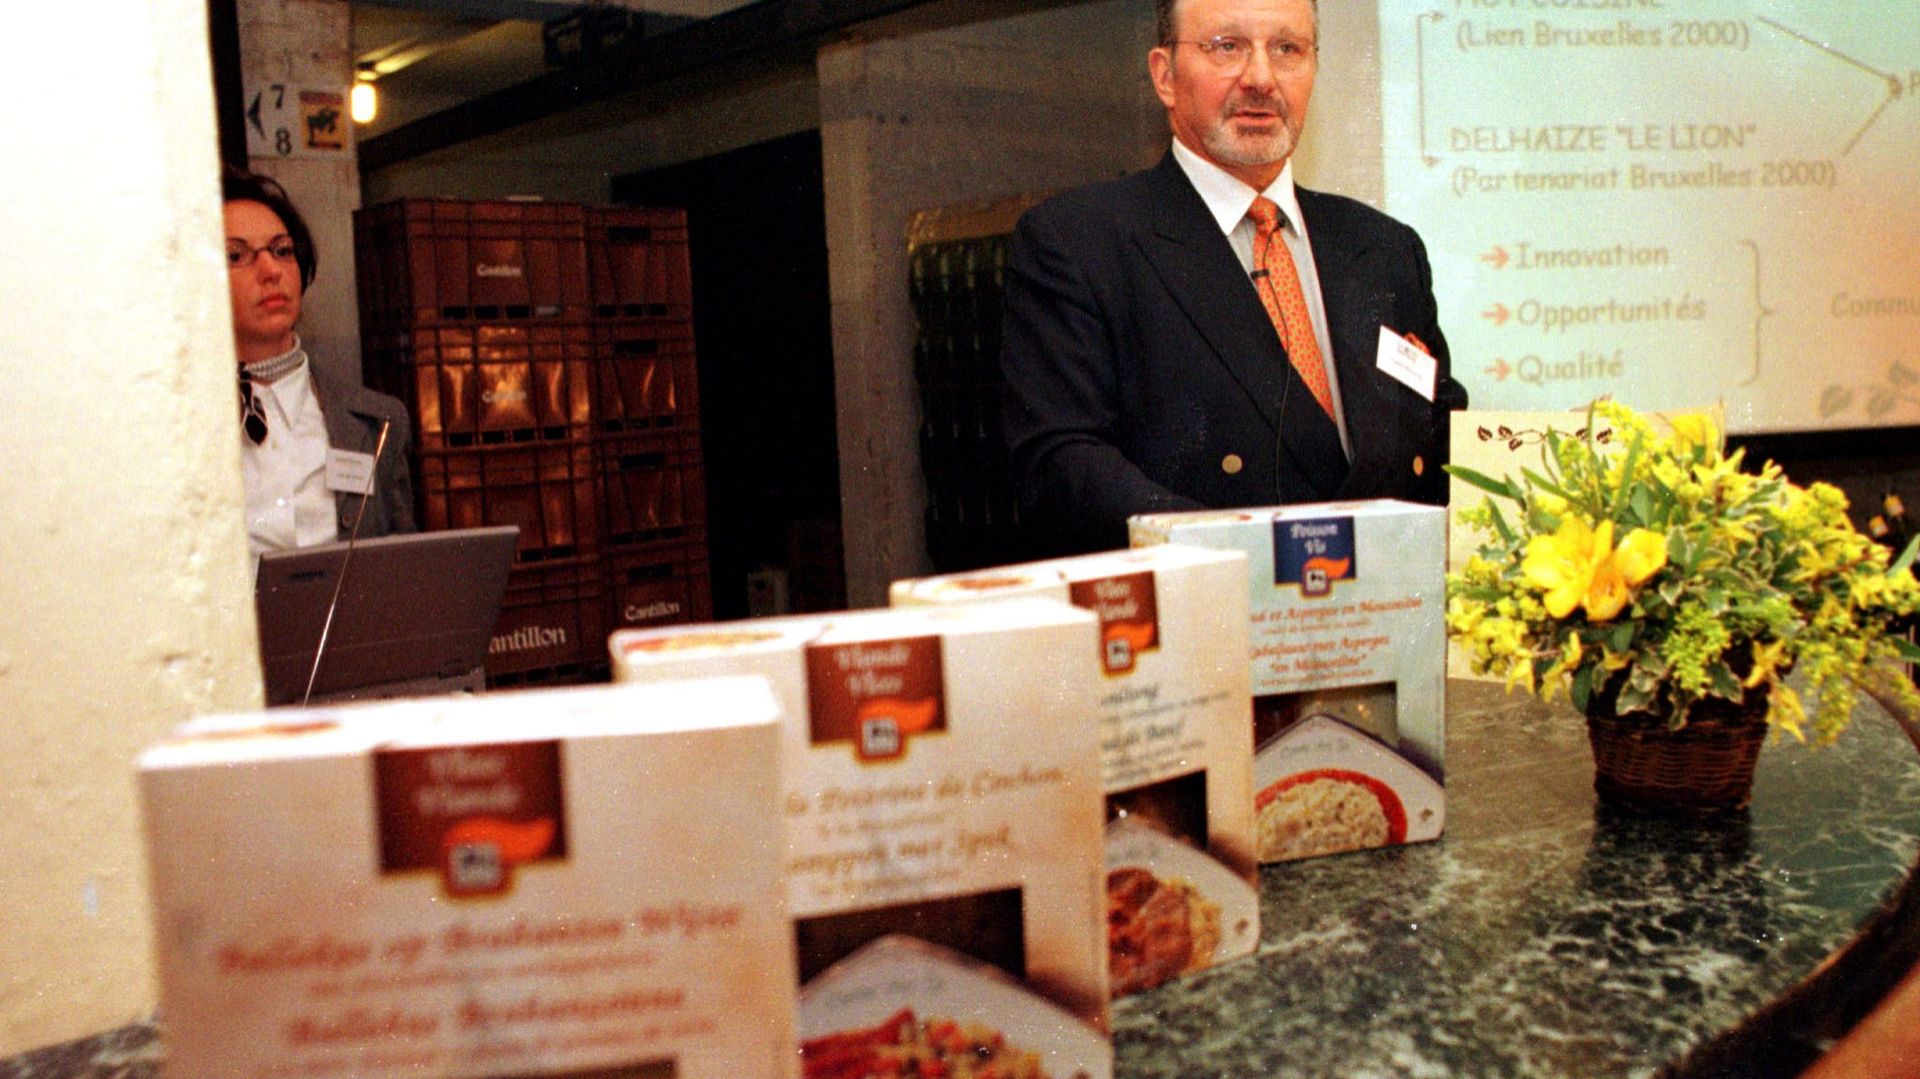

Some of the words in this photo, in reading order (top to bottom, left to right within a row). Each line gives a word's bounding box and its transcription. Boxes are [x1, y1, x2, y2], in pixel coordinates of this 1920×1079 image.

[1457, 20, 1524, 51] (Lien
[1535, 20, 1661, 47] Bruxelles
[1670, 20, 1749, 50] 2000)
[270, 83, 285, 109] 7
[276, 127, 291, 156] 8
[1451, 126, 1602, 152] DELHAIZE
[1617, 124, 1660, 151] "LE
[1670, 122, 1756, 150] LION"
[1451, 165, 1617, 198] (Partenariat
[1630, 162, 1752, 189] Bruxelles
[1762, 159, 1837, 192] 2000)
[1516, 242, 1669, 269] Innovation
[1517, 291, 1706, 333] Opportunités
[1517, 350, 1624, 387] Qualité
[625, 602, 680, 621] Cantillon
[489, 626, 567, 654] antillon
